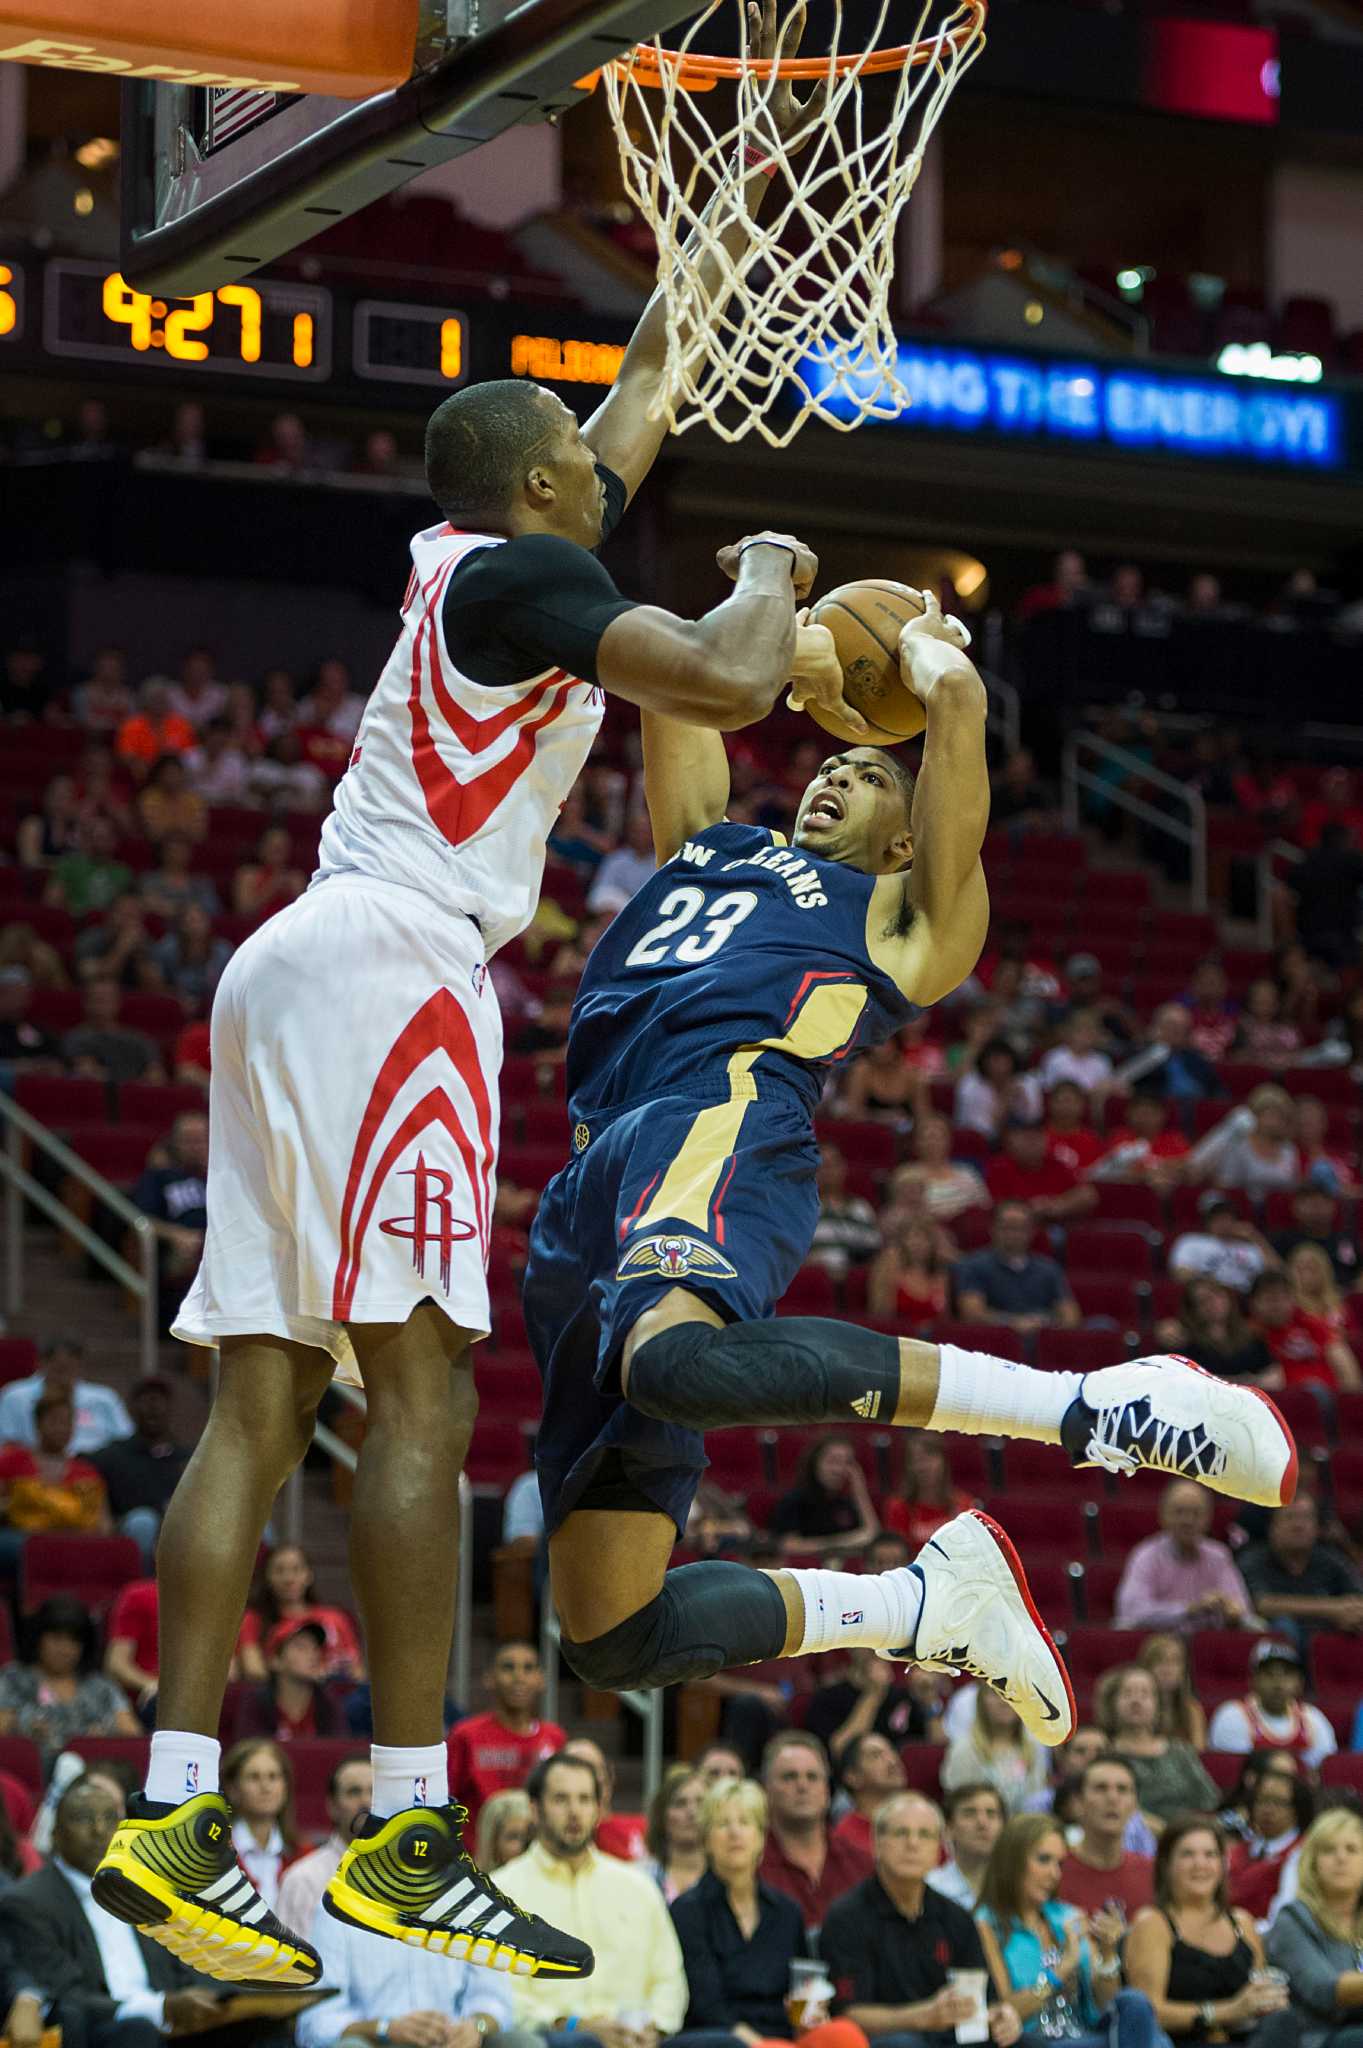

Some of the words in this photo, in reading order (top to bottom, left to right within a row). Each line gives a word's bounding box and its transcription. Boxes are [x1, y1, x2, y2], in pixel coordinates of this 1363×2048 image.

[0, 39, 301, 91] Farm
[625, 886, 758, 967] 23
[207, 1822, 222, 1841] 12
[414, 1840, 428, 1857] 12
